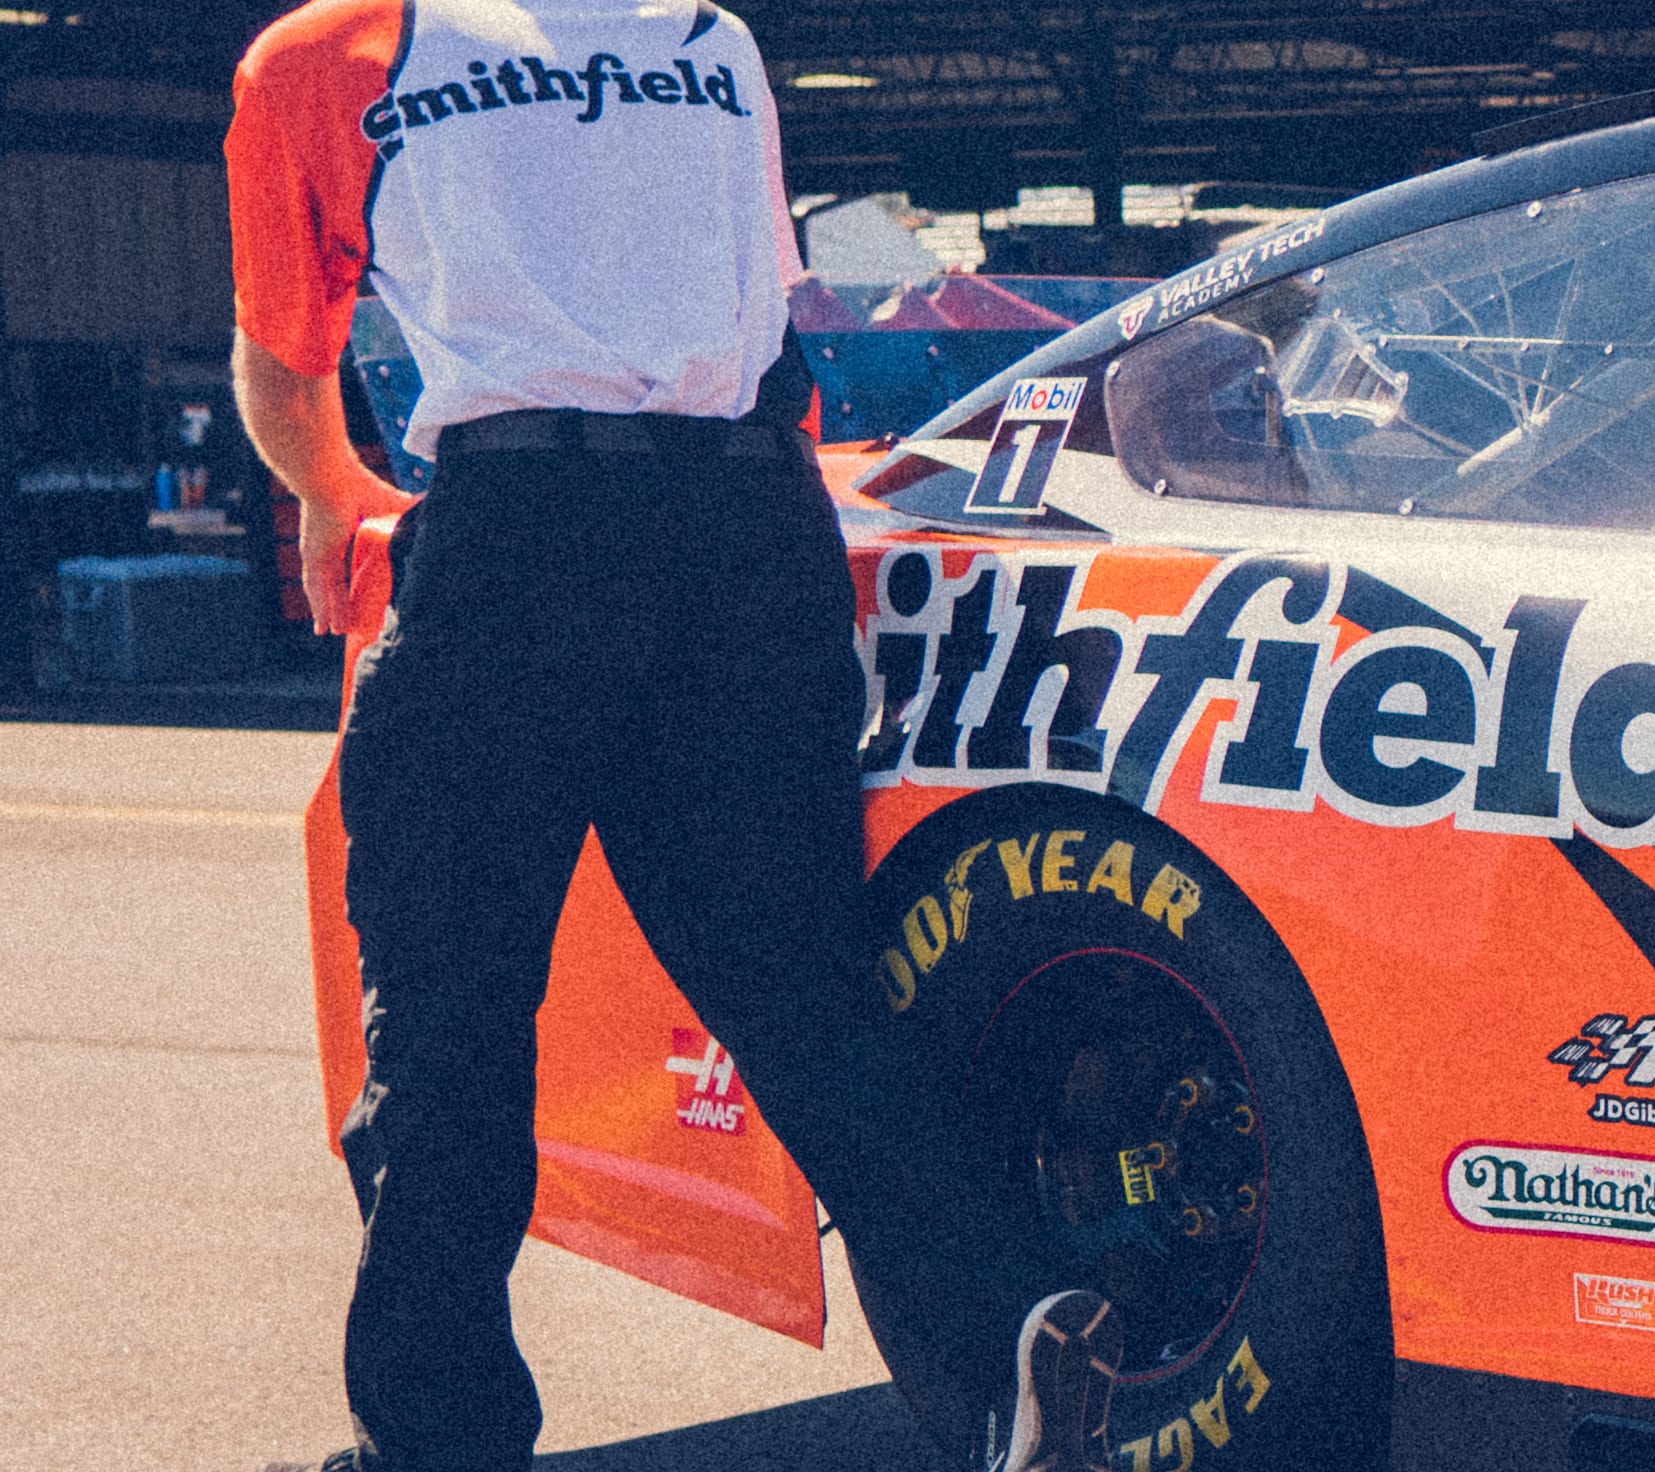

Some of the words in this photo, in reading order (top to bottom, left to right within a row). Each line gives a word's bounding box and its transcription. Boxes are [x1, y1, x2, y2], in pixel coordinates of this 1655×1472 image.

[1158, 268, 1254, 324] ACADEMY
[1161, 251, 1254, 307] VALLEY
[1259, 218, 1327, 263] TECH
[1008, 380, 1084, 413] Mobil
[999, 422, 1043, 509] 1
[876, 830, 1202, 1014] ODYEAR
[1543, 1211, 1614, 1227] FAMOUS
